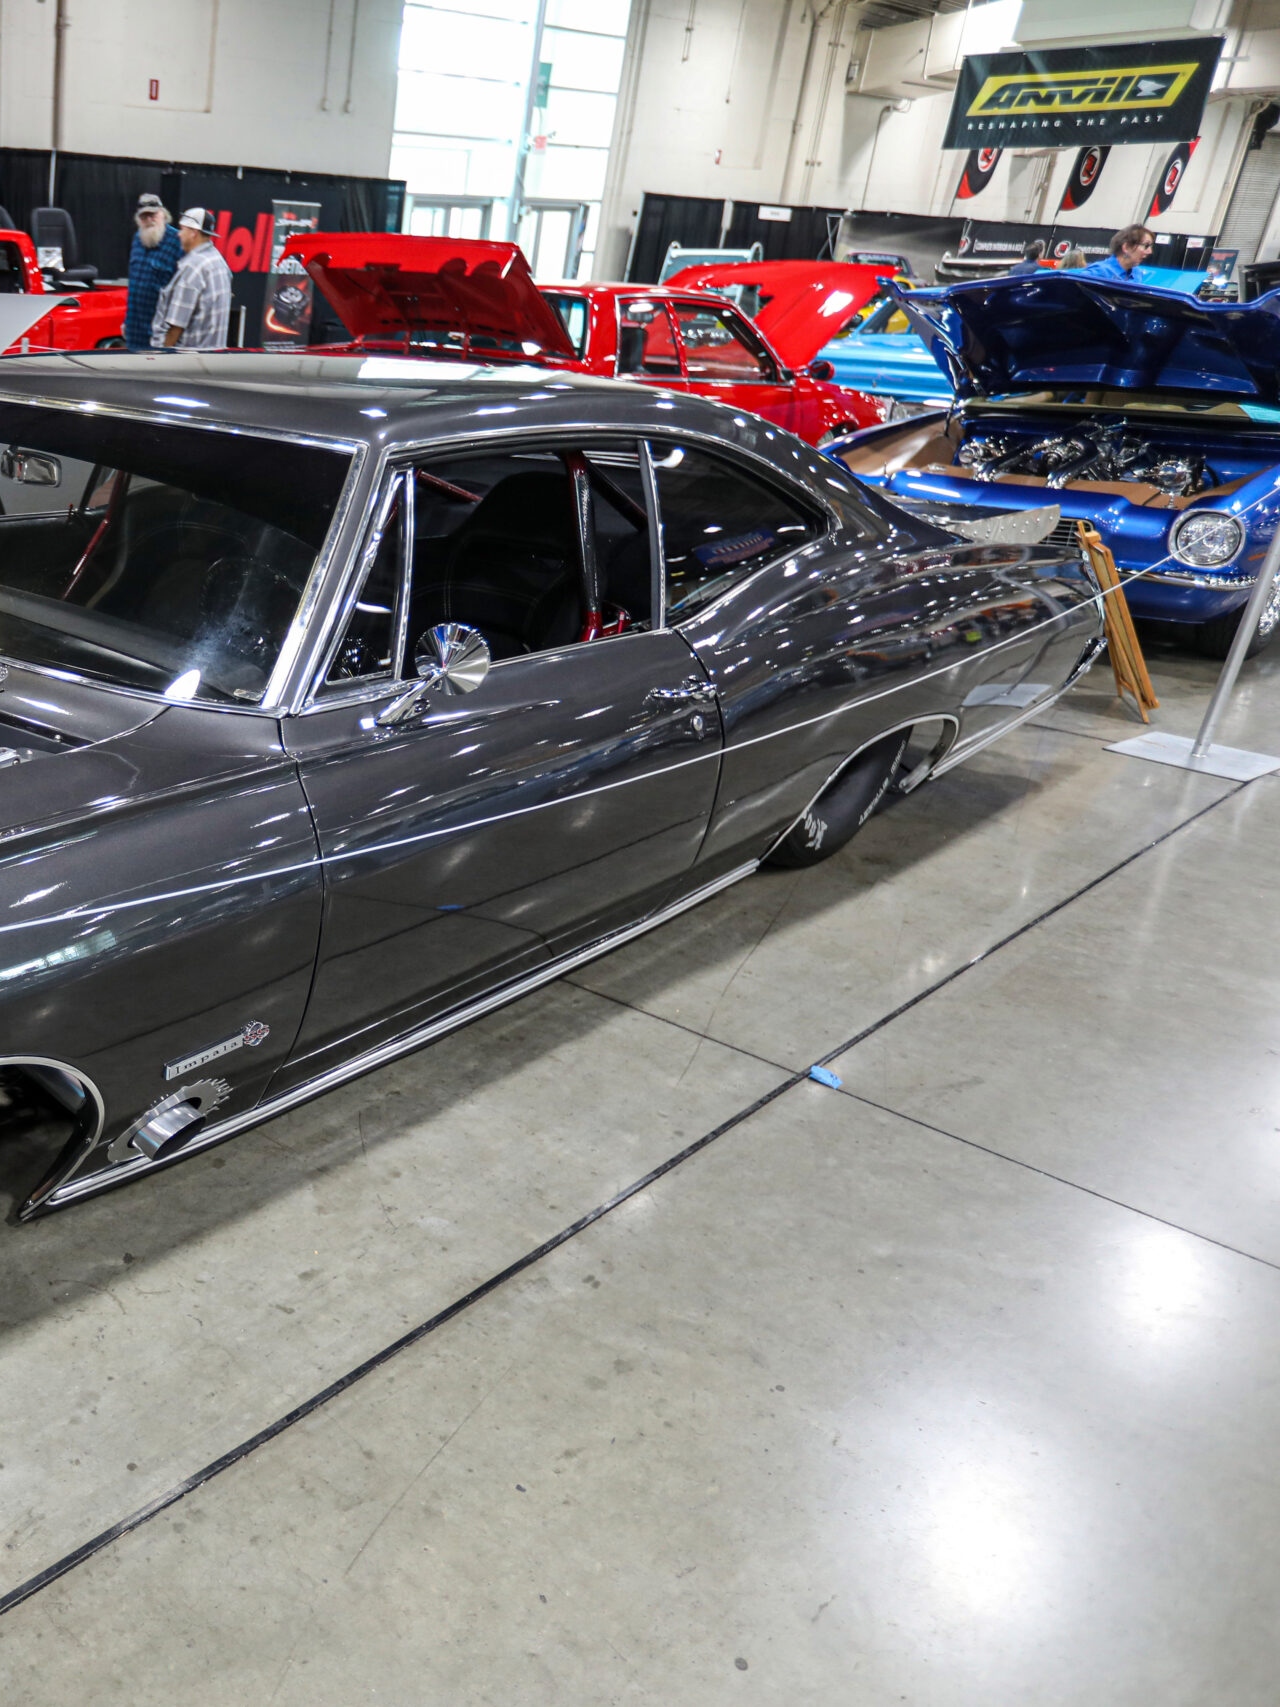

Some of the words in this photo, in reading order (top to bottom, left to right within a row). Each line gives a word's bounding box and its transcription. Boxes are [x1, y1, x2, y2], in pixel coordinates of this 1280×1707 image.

[967, 120, 1063, 131] RESHAPING
[1075, 117, 1107, 127] THE
[1120, 114, 1164, 125] PAST
[175, 1041, 238, 1075] Impala
